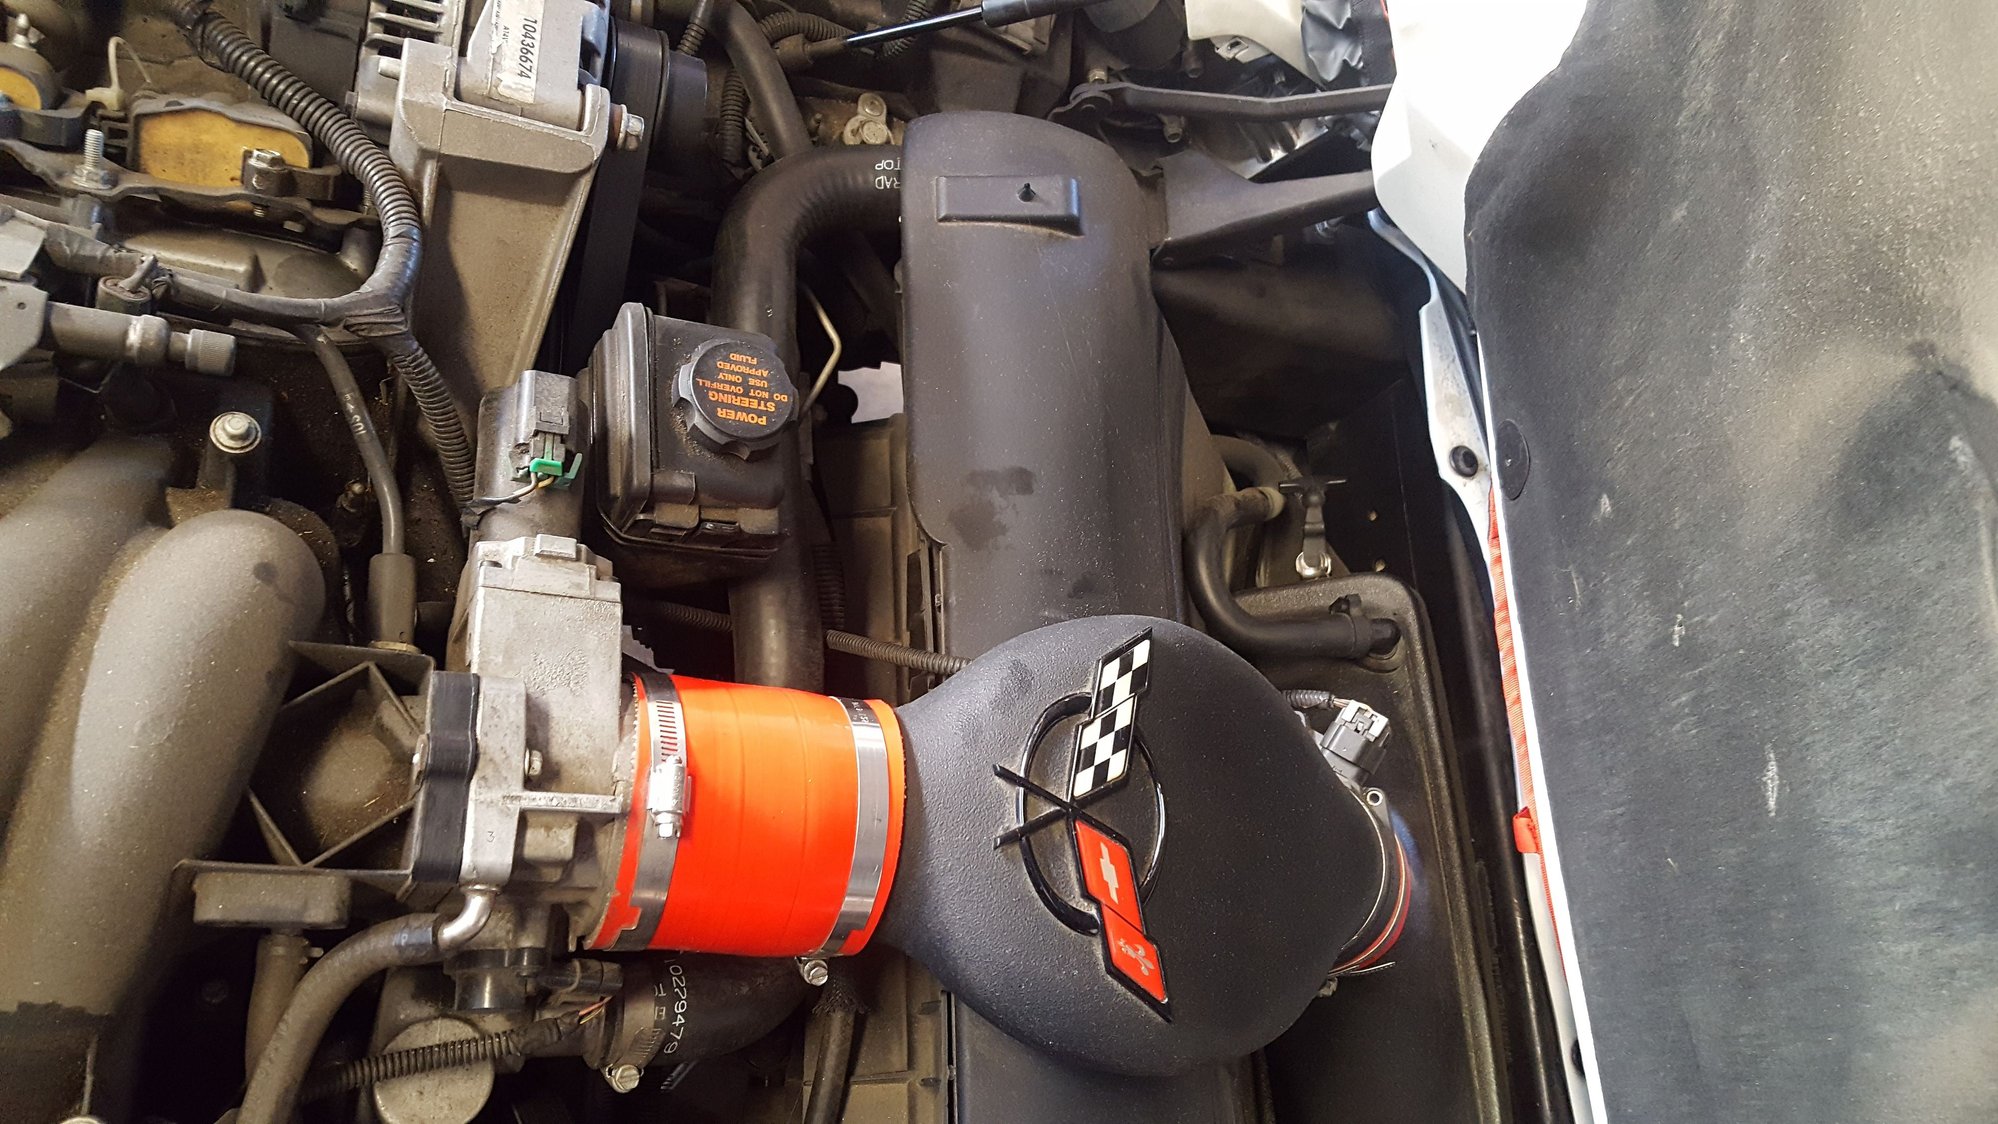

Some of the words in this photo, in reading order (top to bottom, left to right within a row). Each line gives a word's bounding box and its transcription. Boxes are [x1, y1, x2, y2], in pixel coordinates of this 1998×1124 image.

[517, 17, 538, 79] 10436674
[875, 159, 901, 171] TOP
[875, 175, 901, 190] RAD
[729, 352, 757, 365] FLUID
[716, 361, 769, 377] APPROVED
[718, 372, 742, 383] ONLY
[748, 378, 768, 388] USE
[696, 377, 743, 394] OVERFILL
[708, 390, 776, 412] STEERING
[749, 389, 769, 399] NOT
[773, 393, 788, 402] DO
[717, 407, 767, 426] POWER
